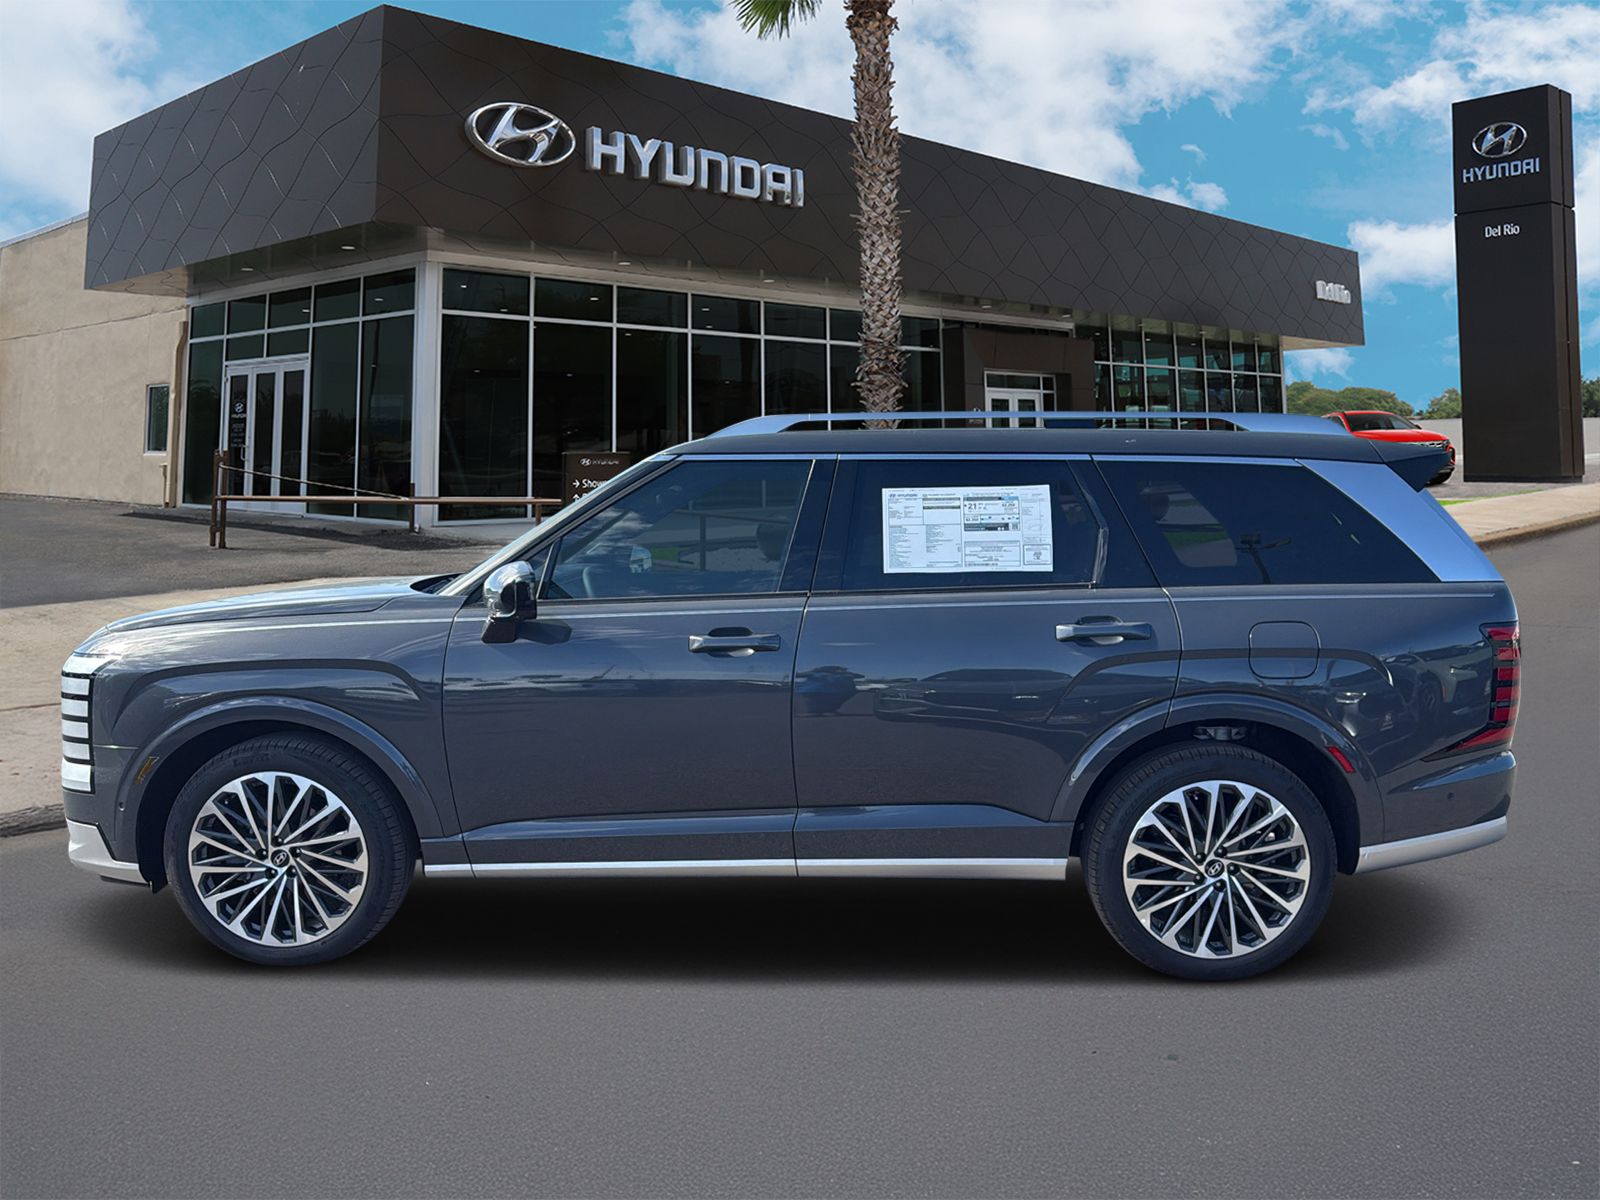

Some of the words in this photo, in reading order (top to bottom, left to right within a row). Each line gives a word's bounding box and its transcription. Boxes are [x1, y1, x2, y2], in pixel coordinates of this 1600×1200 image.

[586, 126, 804, 208] HYUNDAI
[1462, 157, 1540, 183] HYUNDAI
[1484, 225, 1501, 238] Del
[1503, 223, 1520, 235] Rio
